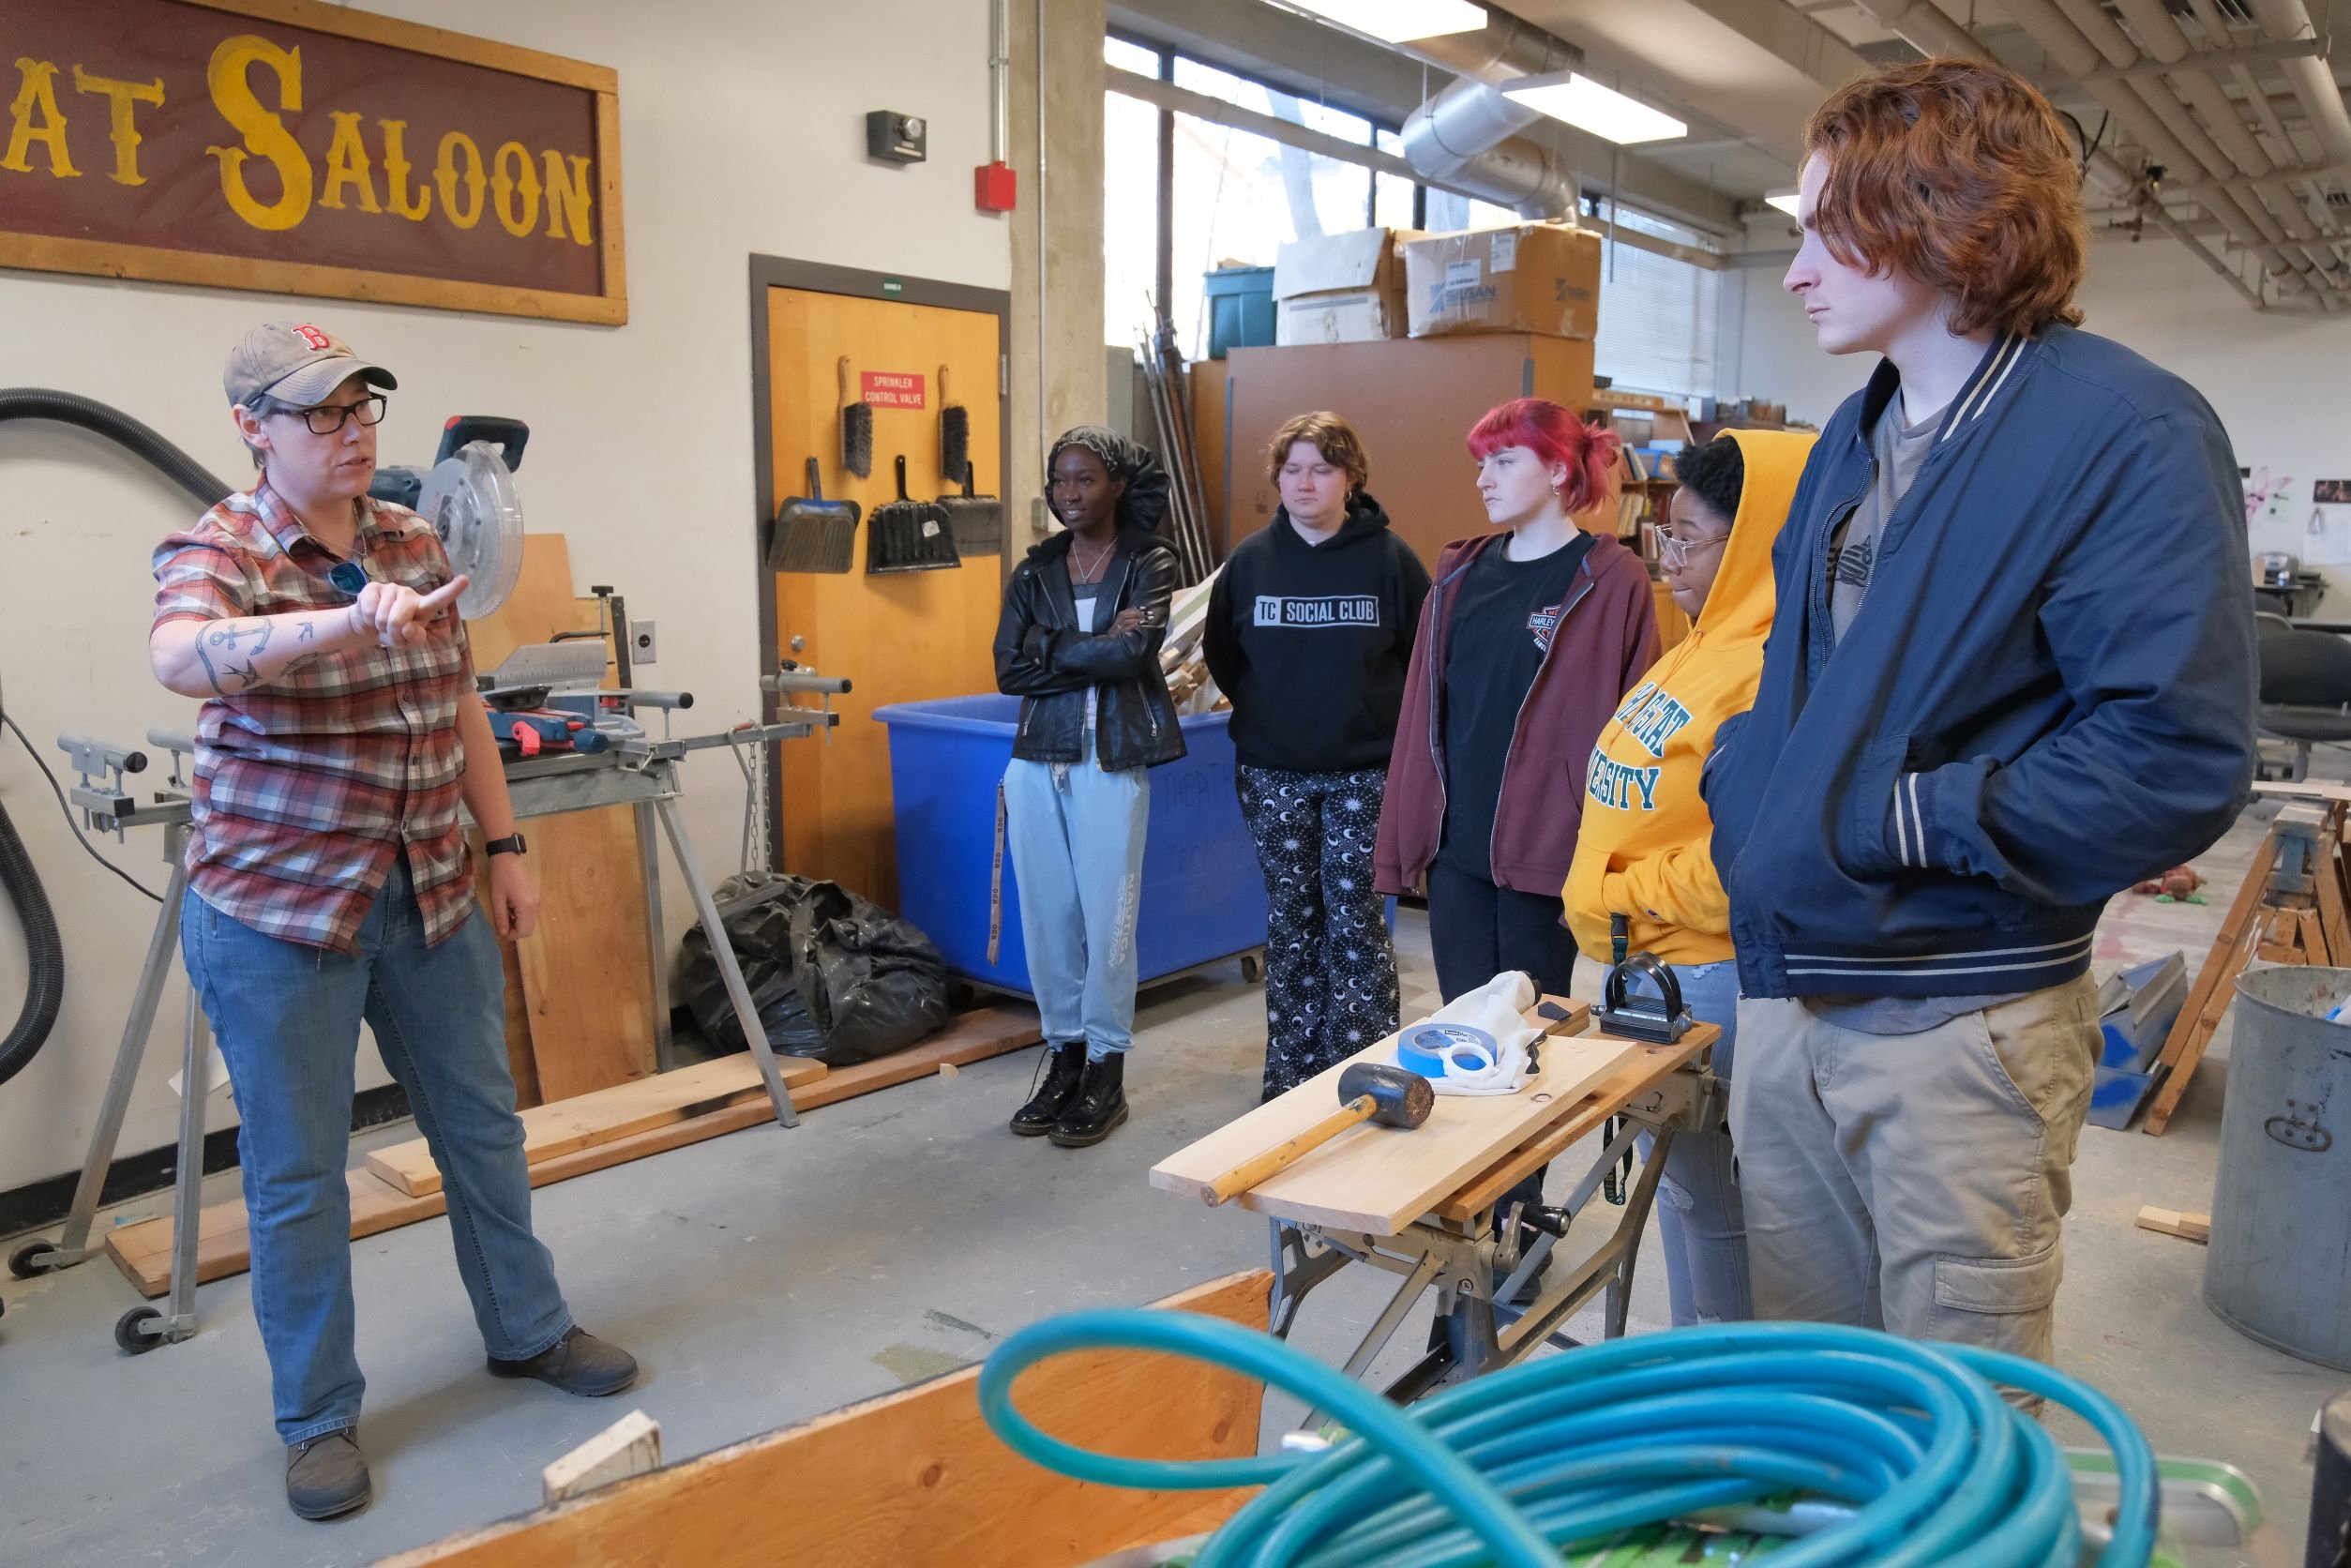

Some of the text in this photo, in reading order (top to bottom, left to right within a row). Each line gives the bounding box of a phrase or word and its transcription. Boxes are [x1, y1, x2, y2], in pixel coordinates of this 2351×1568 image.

[0, 34, 593, 246] AT SALOON
[292, 324, 330, 352] B
[873, 376, 913, 388] SPRINKLER
[865, 391, 922, 404] CONTROL VALVE
[1259, 600, 1375, 622] TC SOCIAL CLUB
[1530, 616, 1555, 626] HARLEY
